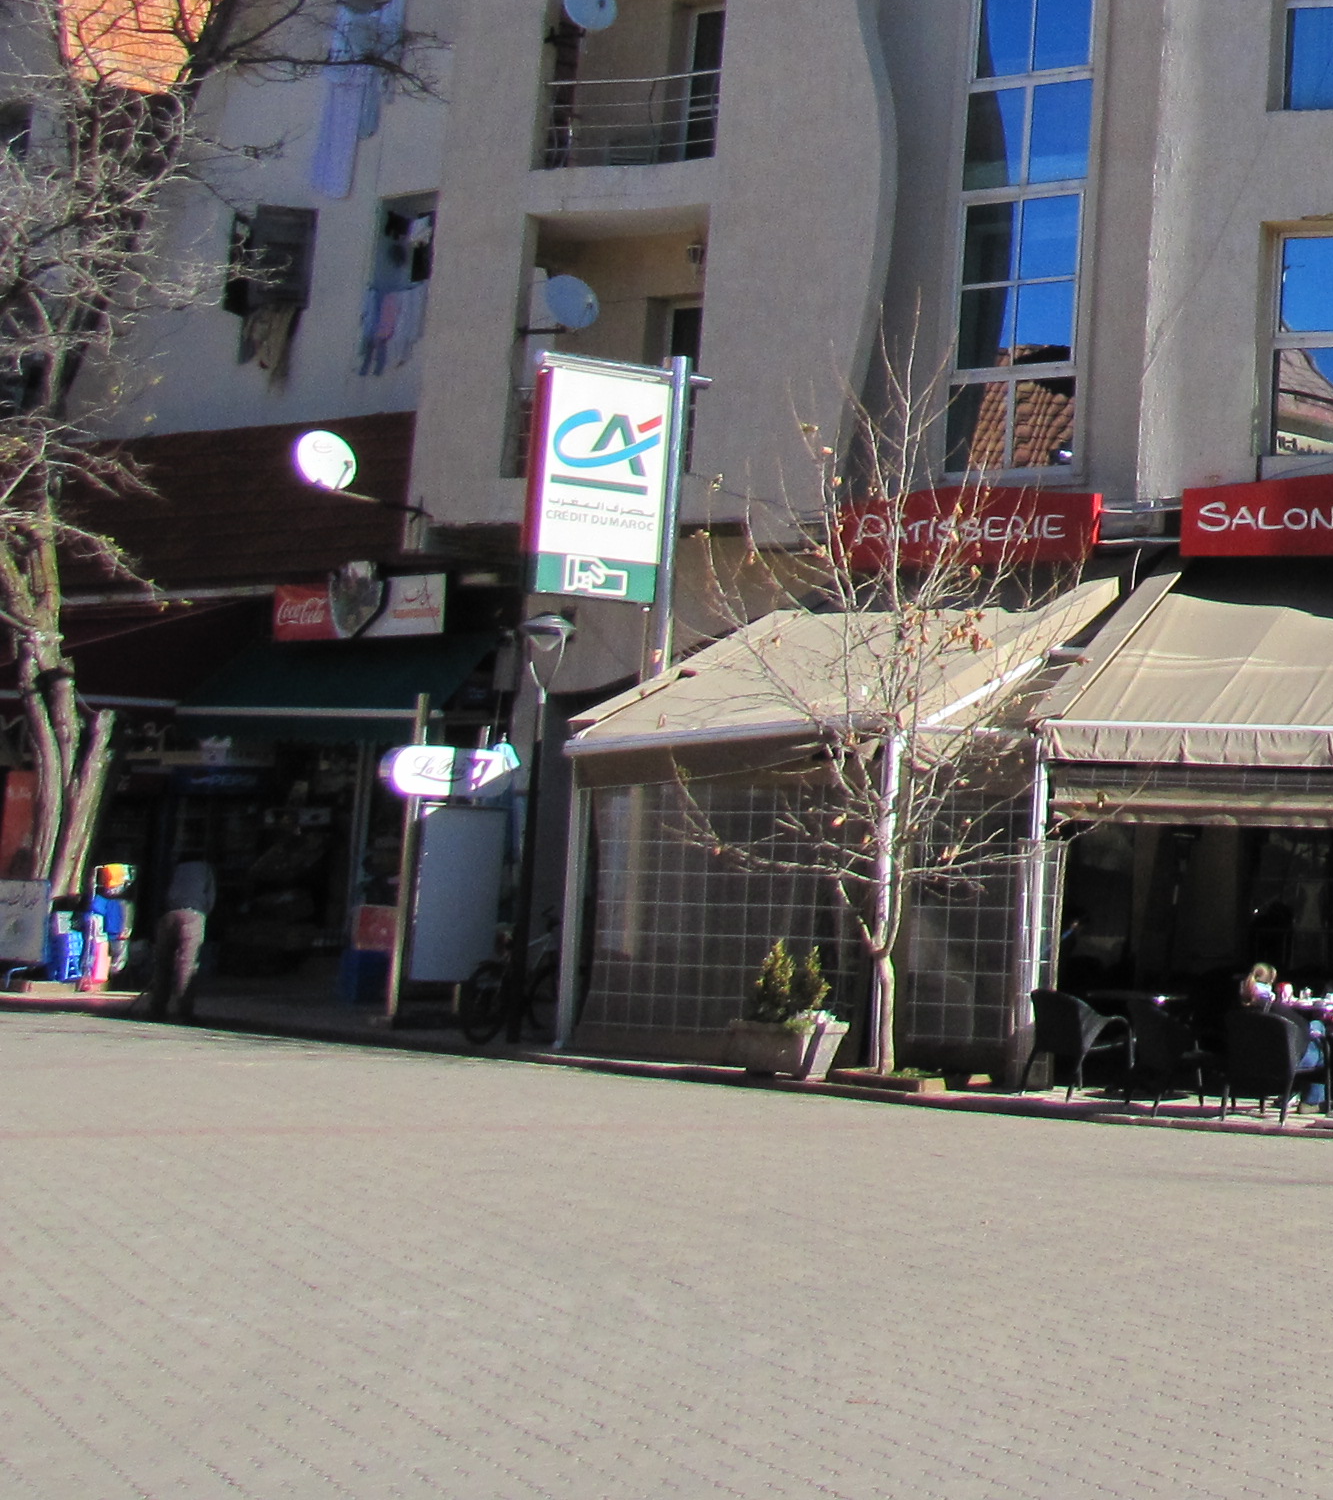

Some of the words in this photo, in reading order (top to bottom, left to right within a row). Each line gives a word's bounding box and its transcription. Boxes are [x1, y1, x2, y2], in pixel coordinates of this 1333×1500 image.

[546, 508, 589, 523] CRÉDIT
[591, 514, 608, 526] DU
[609, 517, 655, 532] MAROC
